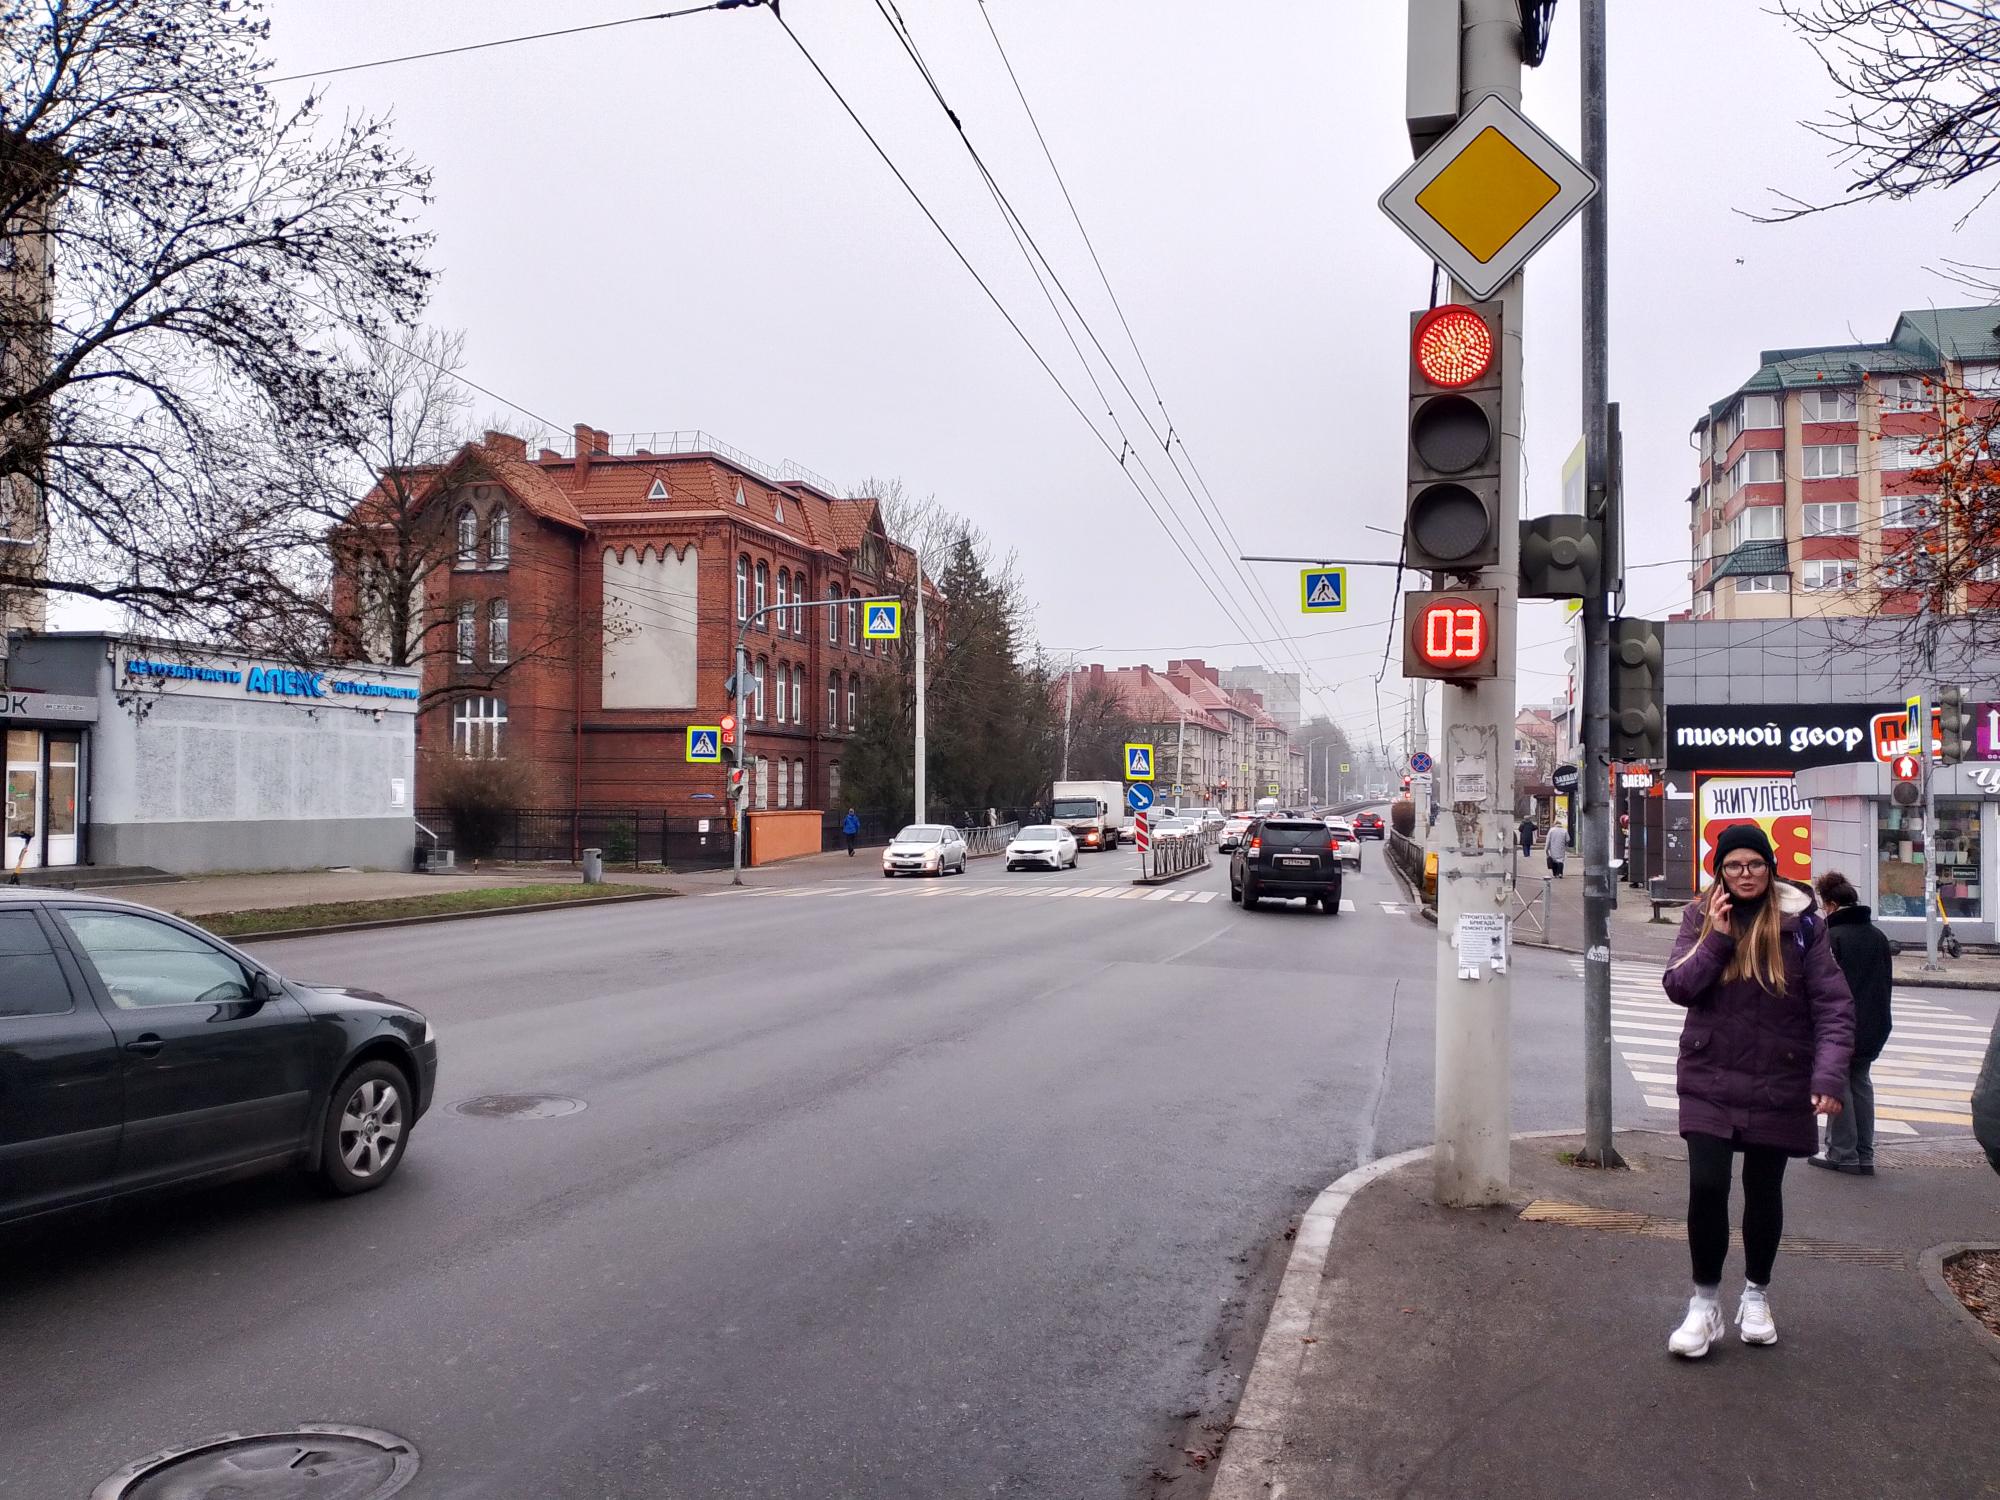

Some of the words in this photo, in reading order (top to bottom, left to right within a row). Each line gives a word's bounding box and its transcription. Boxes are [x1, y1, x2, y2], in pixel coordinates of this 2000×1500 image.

[1426, 609, 1480, 657] 03
[246, 667, 326, 698] АПЕКС
[1677, 722, 1782, 747] пивной
[1789, 726, 1864, 752] двор
[1621, 773, 1653, 788] ЗДЕСЬ!
